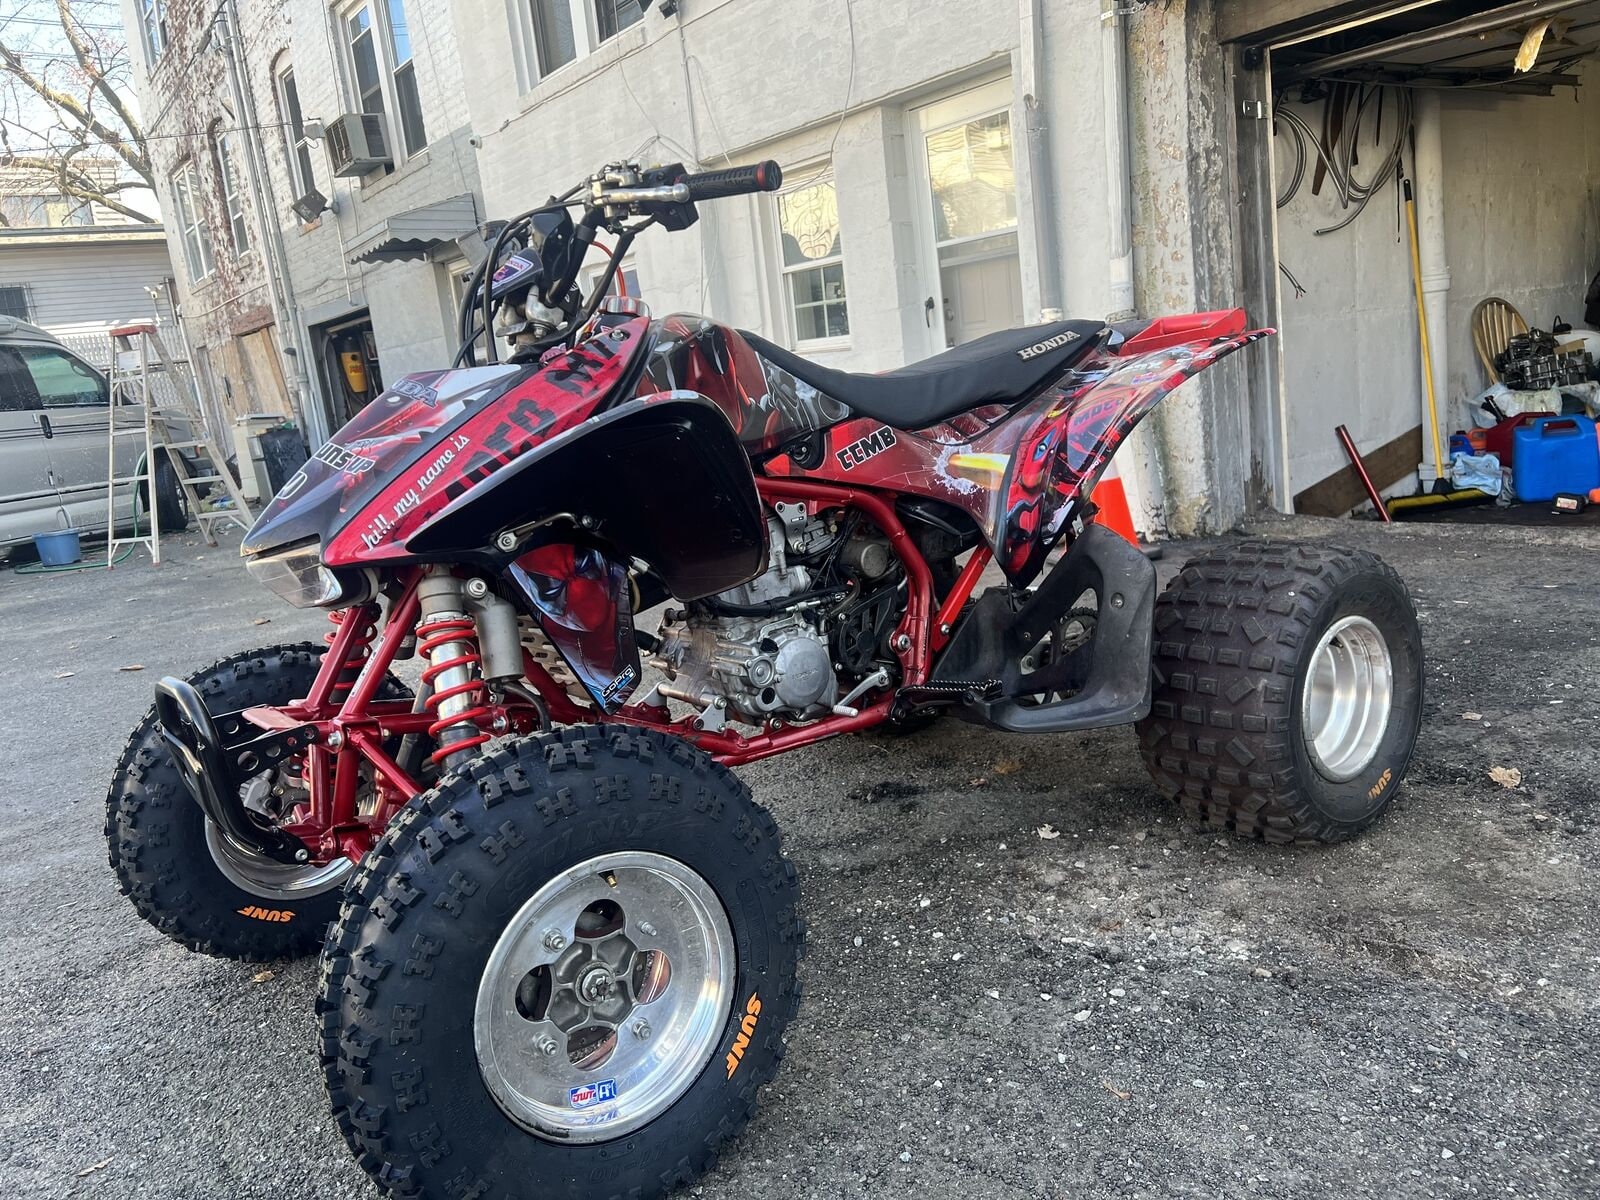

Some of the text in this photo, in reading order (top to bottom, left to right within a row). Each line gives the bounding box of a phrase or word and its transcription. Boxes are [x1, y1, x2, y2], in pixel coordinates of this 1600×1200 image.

[1017, 330, 1081, 360] HONDA
[393, 489, 419, 518] my
[417, 449, 456, 491] name
[450, 434, 470, 451] is
[601, 667, 632, 697] GoPro
[237, 905, 296, 922] SUNF
[725, 991, 762, 1081] SUNF
